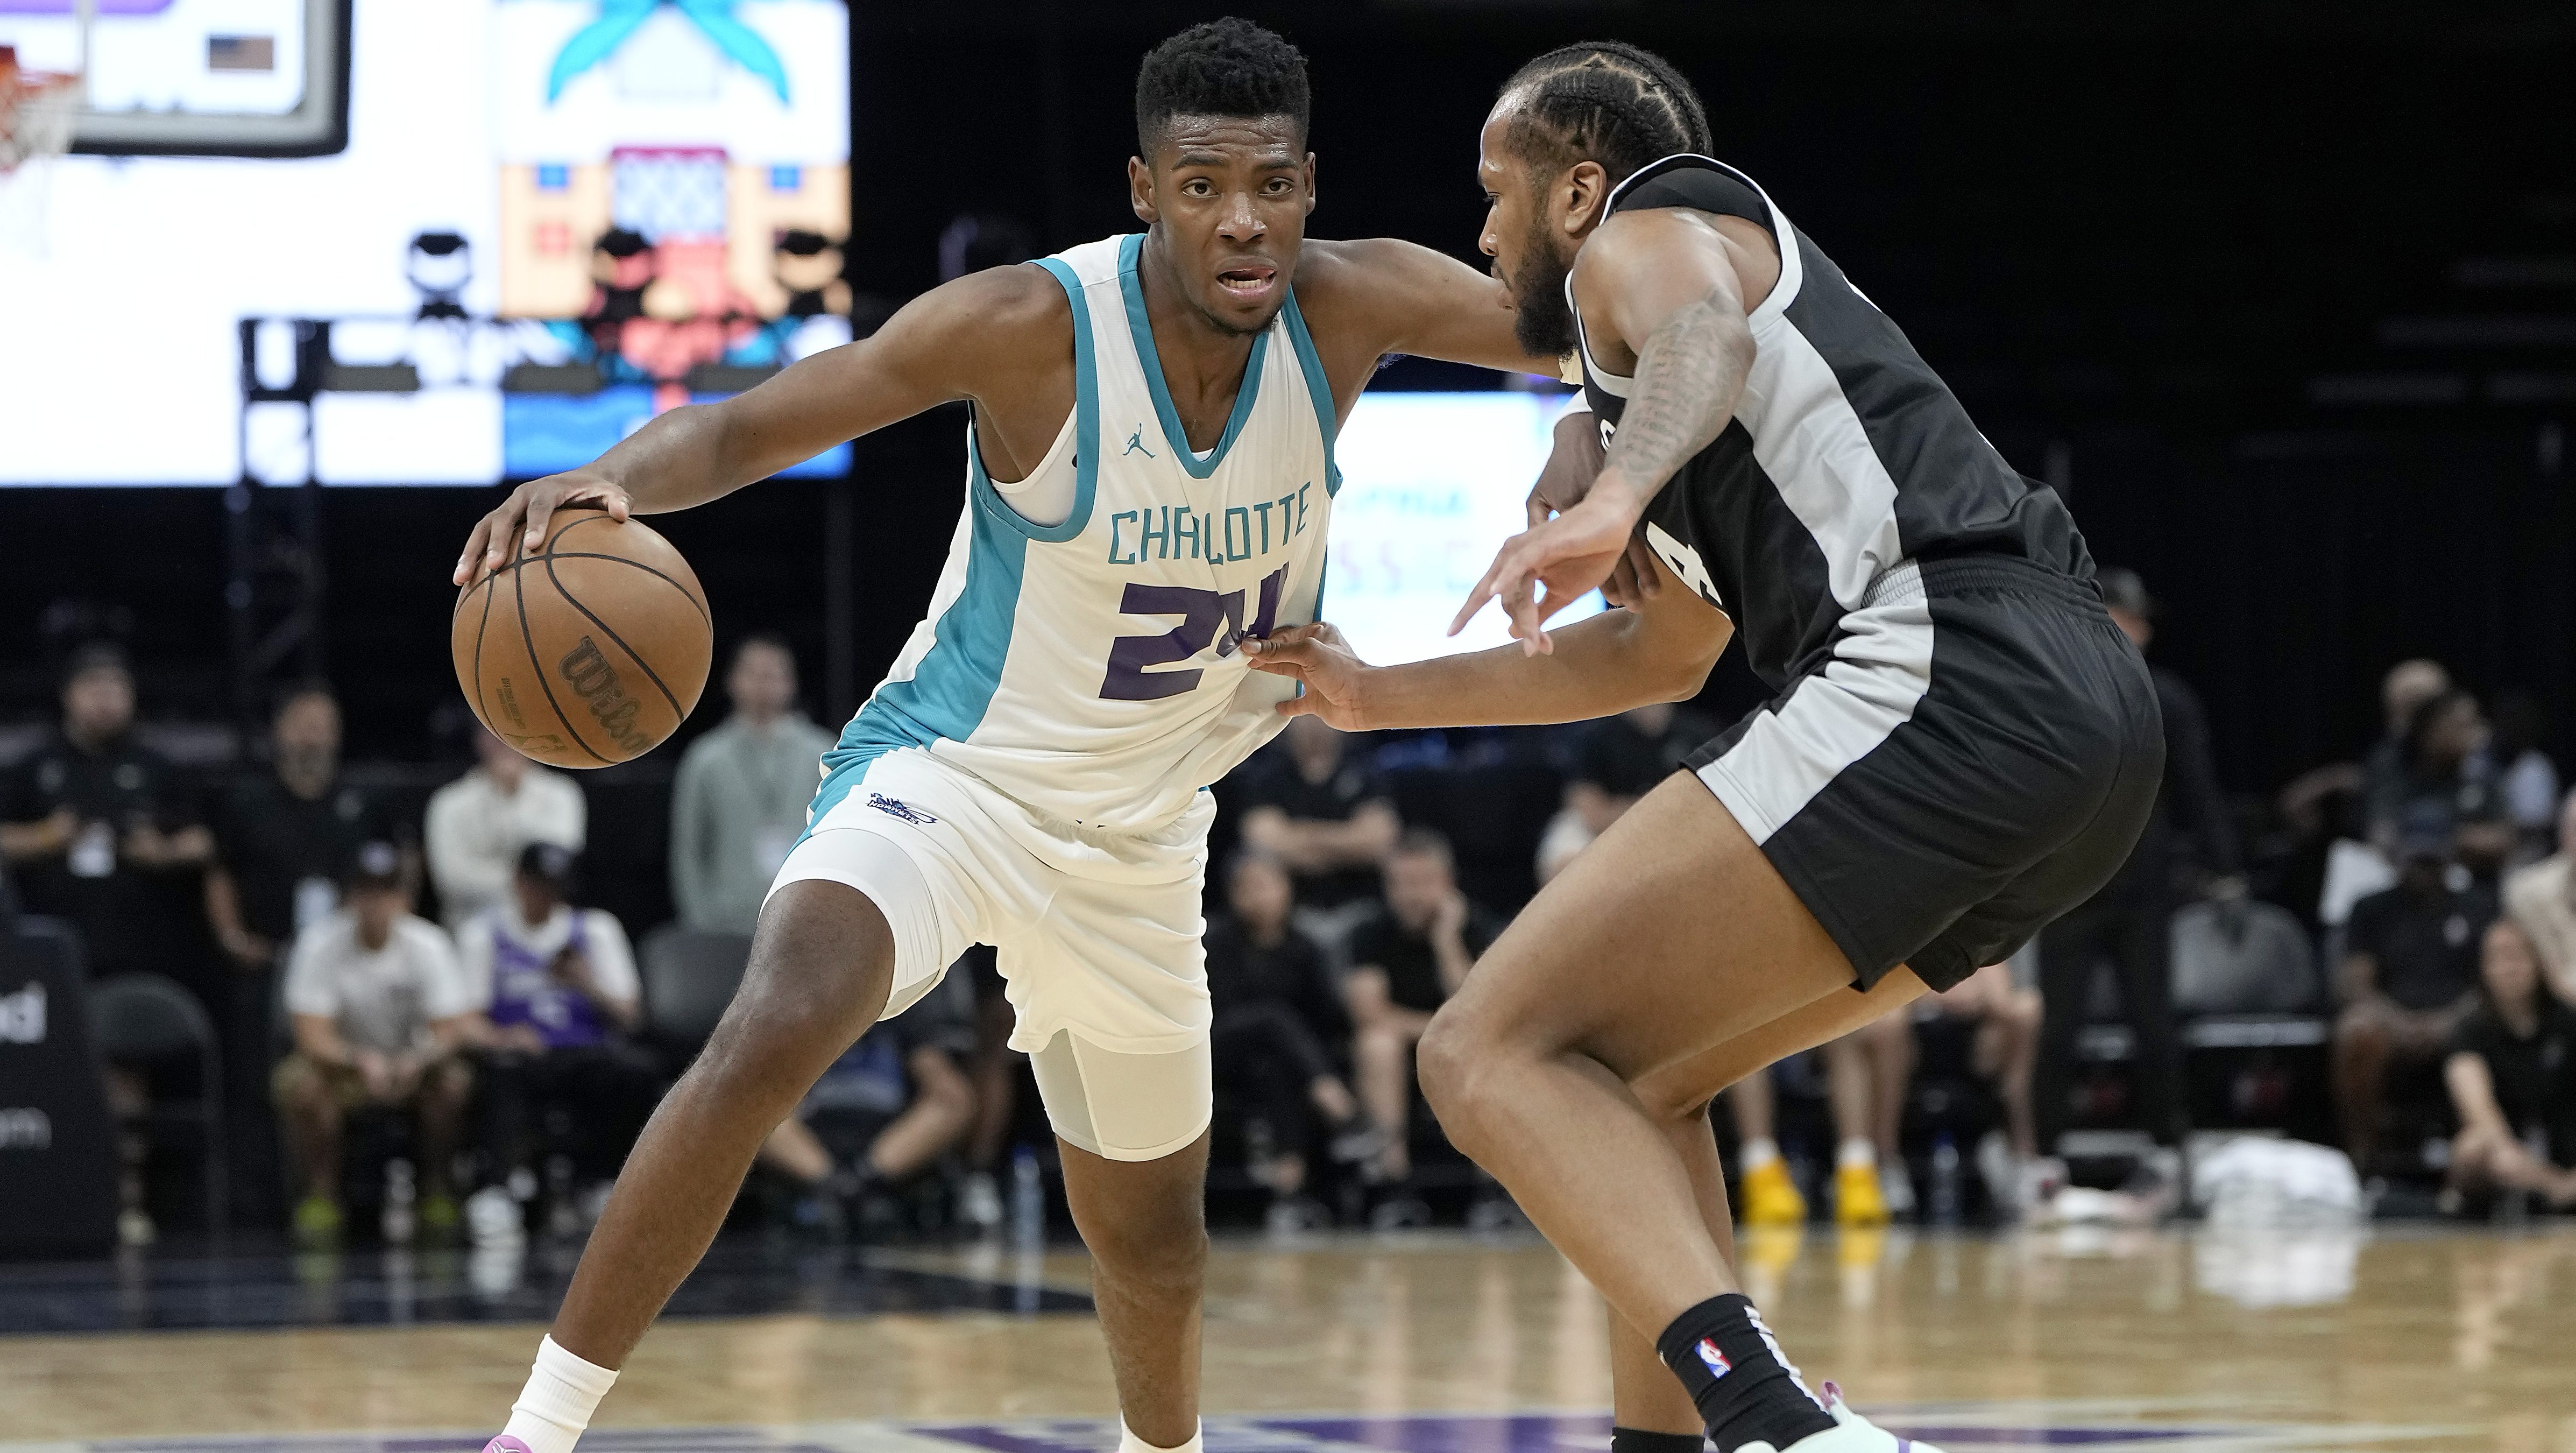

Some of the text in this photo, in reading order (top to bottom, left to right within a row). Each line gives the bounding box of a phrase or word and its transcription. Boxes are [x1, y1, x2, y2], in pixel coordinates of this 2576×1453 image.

[1108, 481, 1311, 565] CHALOTTE
[1099, 561, 1289, 701] 24
[559, 635, 649, 754] Wilso
